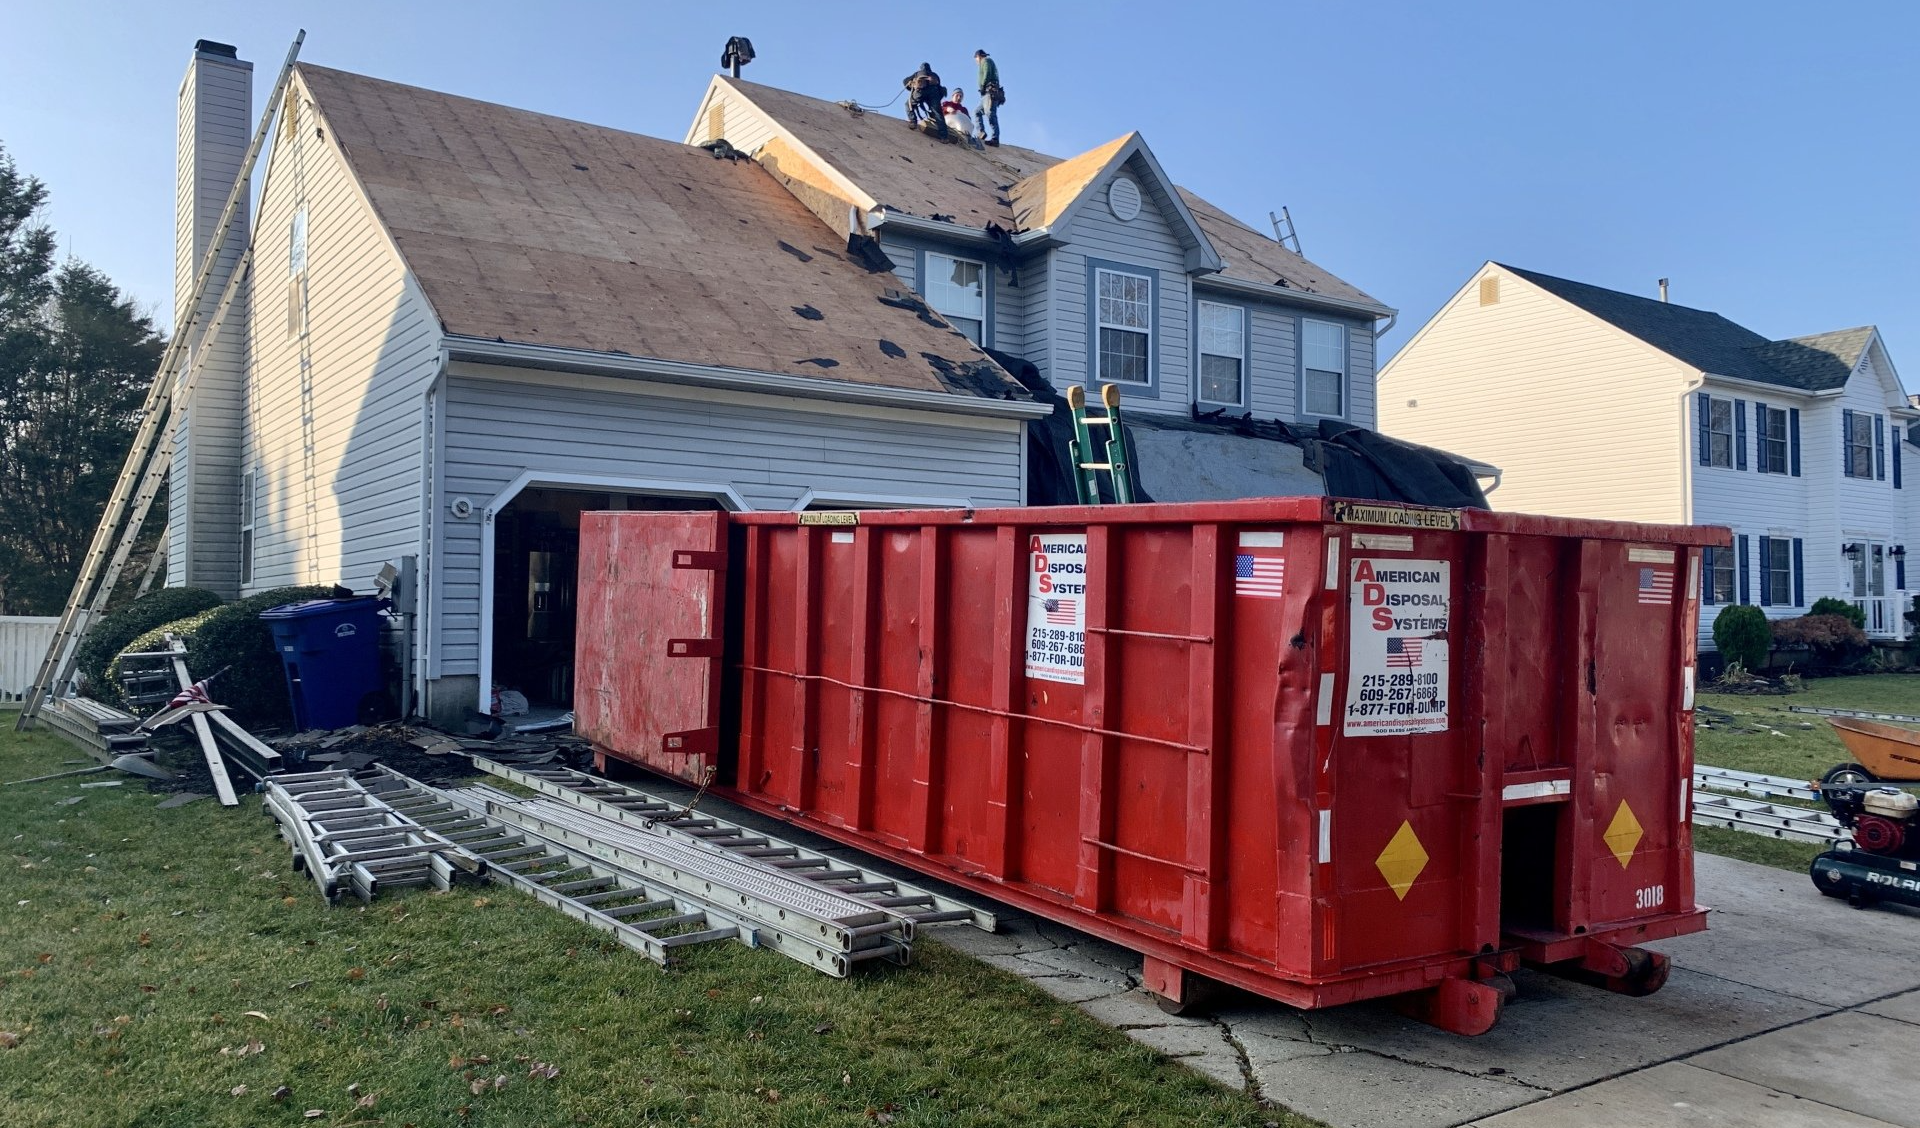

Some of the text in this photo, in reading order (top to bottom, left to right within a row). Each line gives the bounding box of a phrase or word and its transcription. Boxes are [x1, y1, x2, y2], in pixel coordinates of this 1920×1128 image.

[841, 515, 854, 524] LEVEL
[1347, 508, 1387, 523] MAXIMUM
[1424, 514, 1450, 528] LEVEL
[1034, 554, 1087, 574] DISPOS
[1354, 559, 1440, 583] AMERICAN
[1039, 573, 1086, 594] SYSTE
[1363, 583, 1446, 606] DISPOSAL
[1372, 606, 1447, 631] SYSTEMS
[1032, 627, 1085, 642] 215-289-810
[1031, 639, 1085, 654] 609-267-686
[1025, 650, 1084, 667] 1-877-FOR-DU
[1362, 672, 1438, 687] 215-289-8100
[1360, 686, 1438, 701] 609-267-6868
[1348, 700, 1446, 716] 1-877-FOR-DUMP
[1866, 871, 1920, 892] ROLAI
[1636, 884, 1664, 909] 3018
